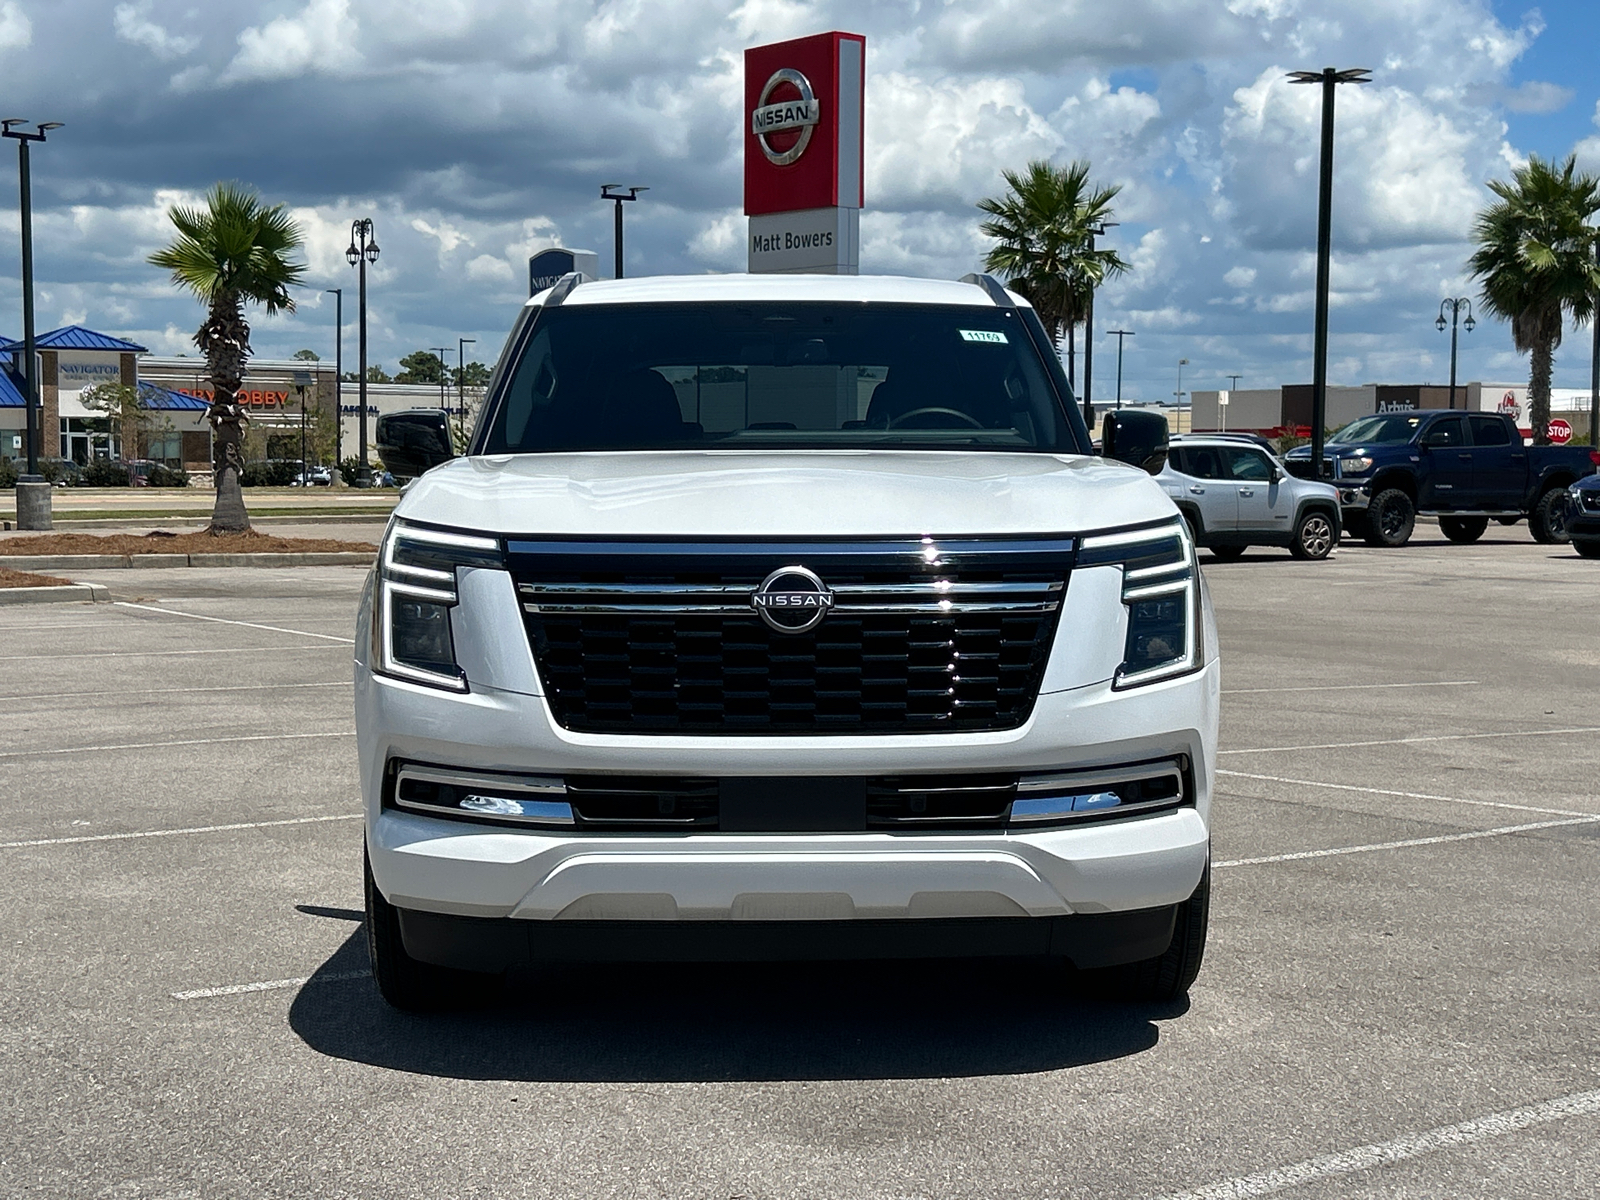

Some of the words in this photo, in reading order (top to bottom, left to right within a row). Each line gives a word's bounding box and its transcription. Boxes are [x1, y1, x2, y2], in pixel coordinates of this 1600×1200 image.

[755, 105, 809, 128] NISSAN
[753, 234, 781, 253] Matt
[785, 231, 833, 249] Bowers
[60, 364, 120, 375] NAVIGATOR
[238, 390, 289, 405] OBBY
[1548, 425, 1571, 438] STOP
[753, 595, 832, 606] NISSAN
